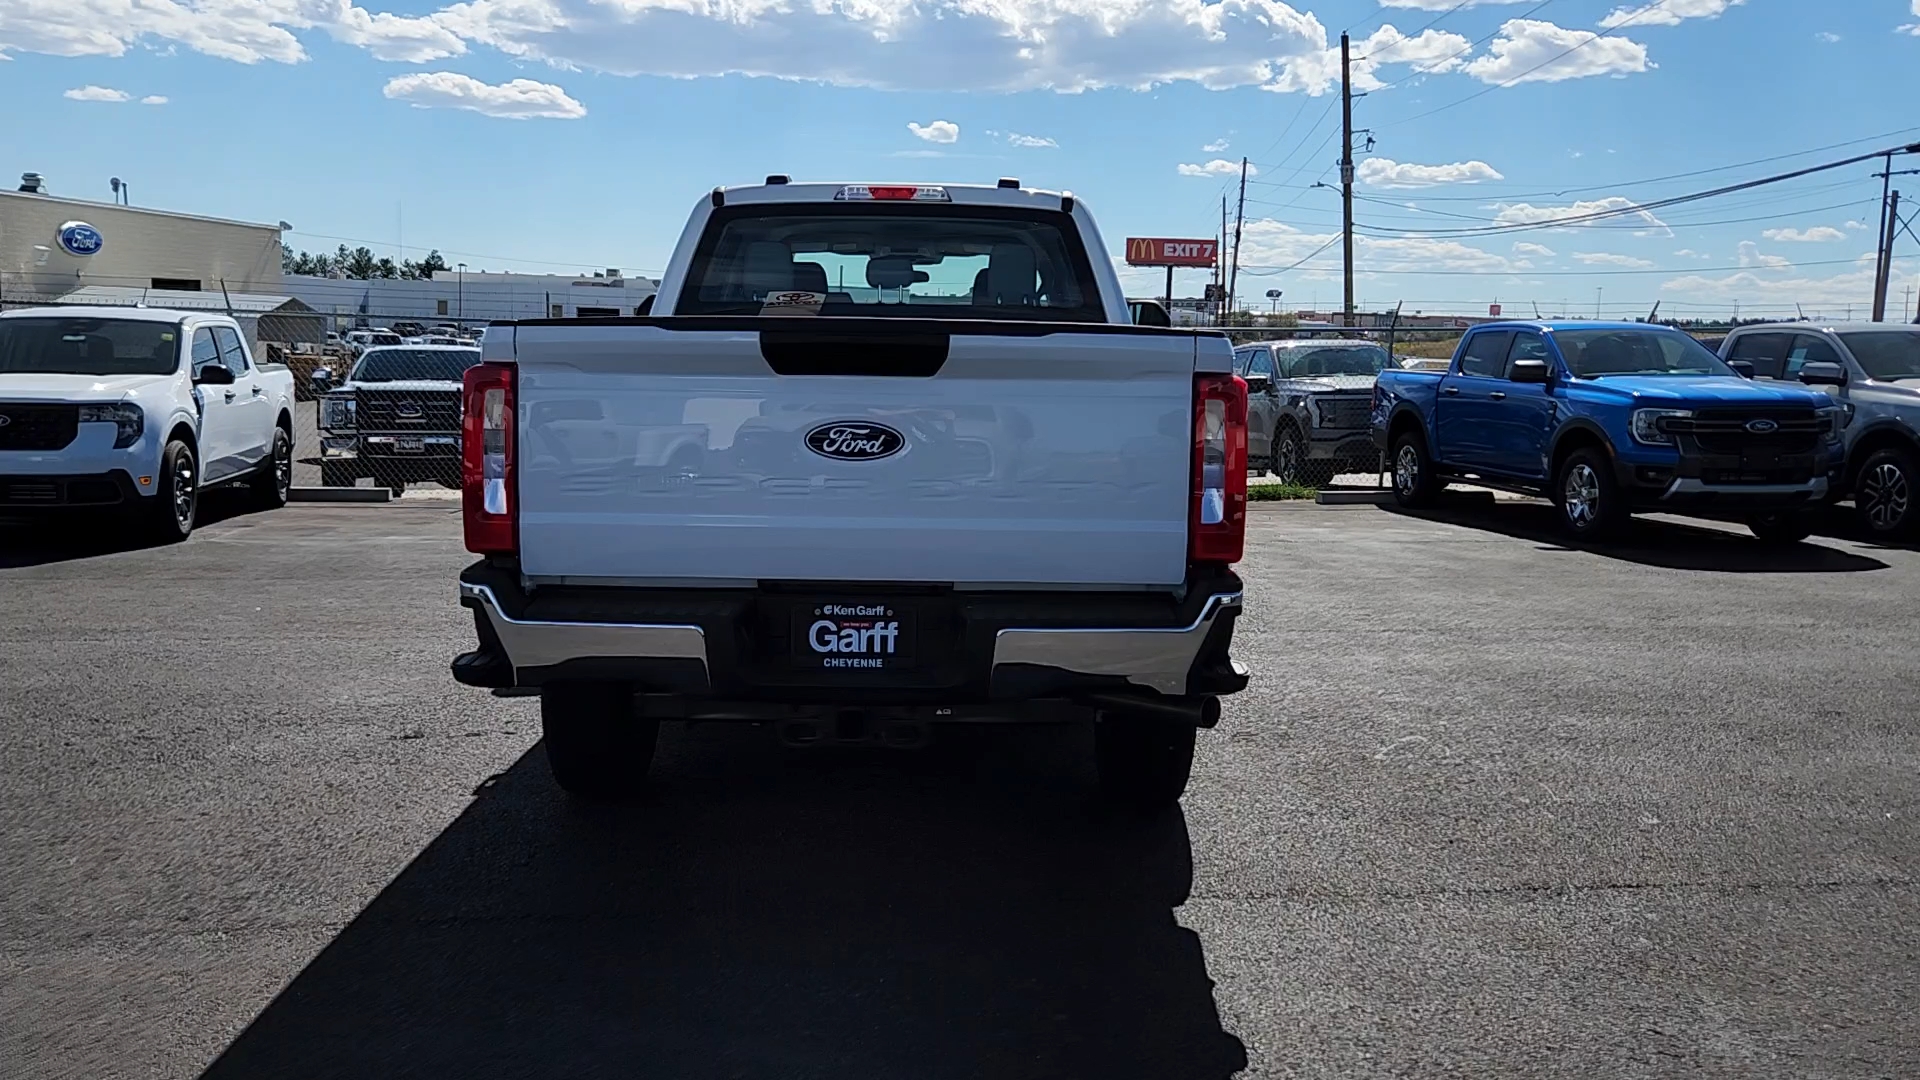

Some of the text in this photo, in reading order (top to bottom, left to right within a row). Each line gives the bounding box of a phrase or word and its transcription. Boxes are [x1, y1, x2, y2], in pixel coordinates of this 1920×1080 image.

[72, 229, 96, 249] Ford
[1163, 243, 1213, 257] EXIT 7
[823, 427, 886, 453] Ford
[833, 604, 885, 616] Ken Garff
[809, 619, 899, 653] Garff
[823, 658, 883, 668] CHEYENNE
